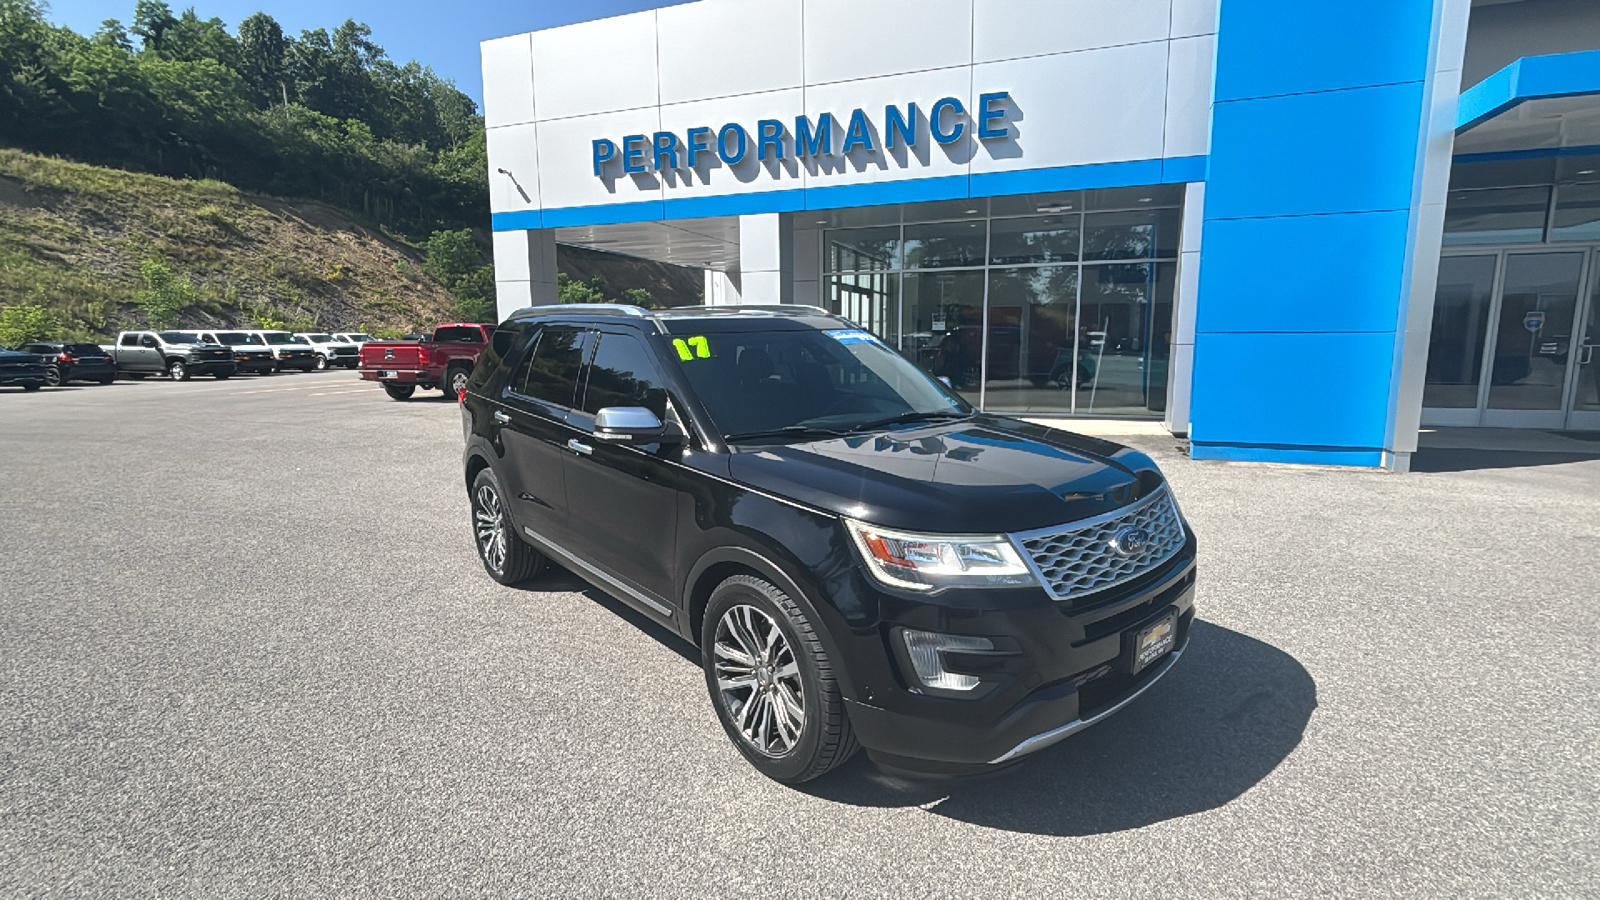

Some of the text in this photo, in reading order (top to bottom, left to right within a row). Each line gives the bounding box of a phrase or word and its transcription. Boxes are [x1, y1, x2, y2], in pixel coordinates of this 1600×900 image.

[592, 91, 1009, 177] PERFORMANCE
[672, 335, 711, 361] 17
[1127, 531, 1146, 551] Ford
